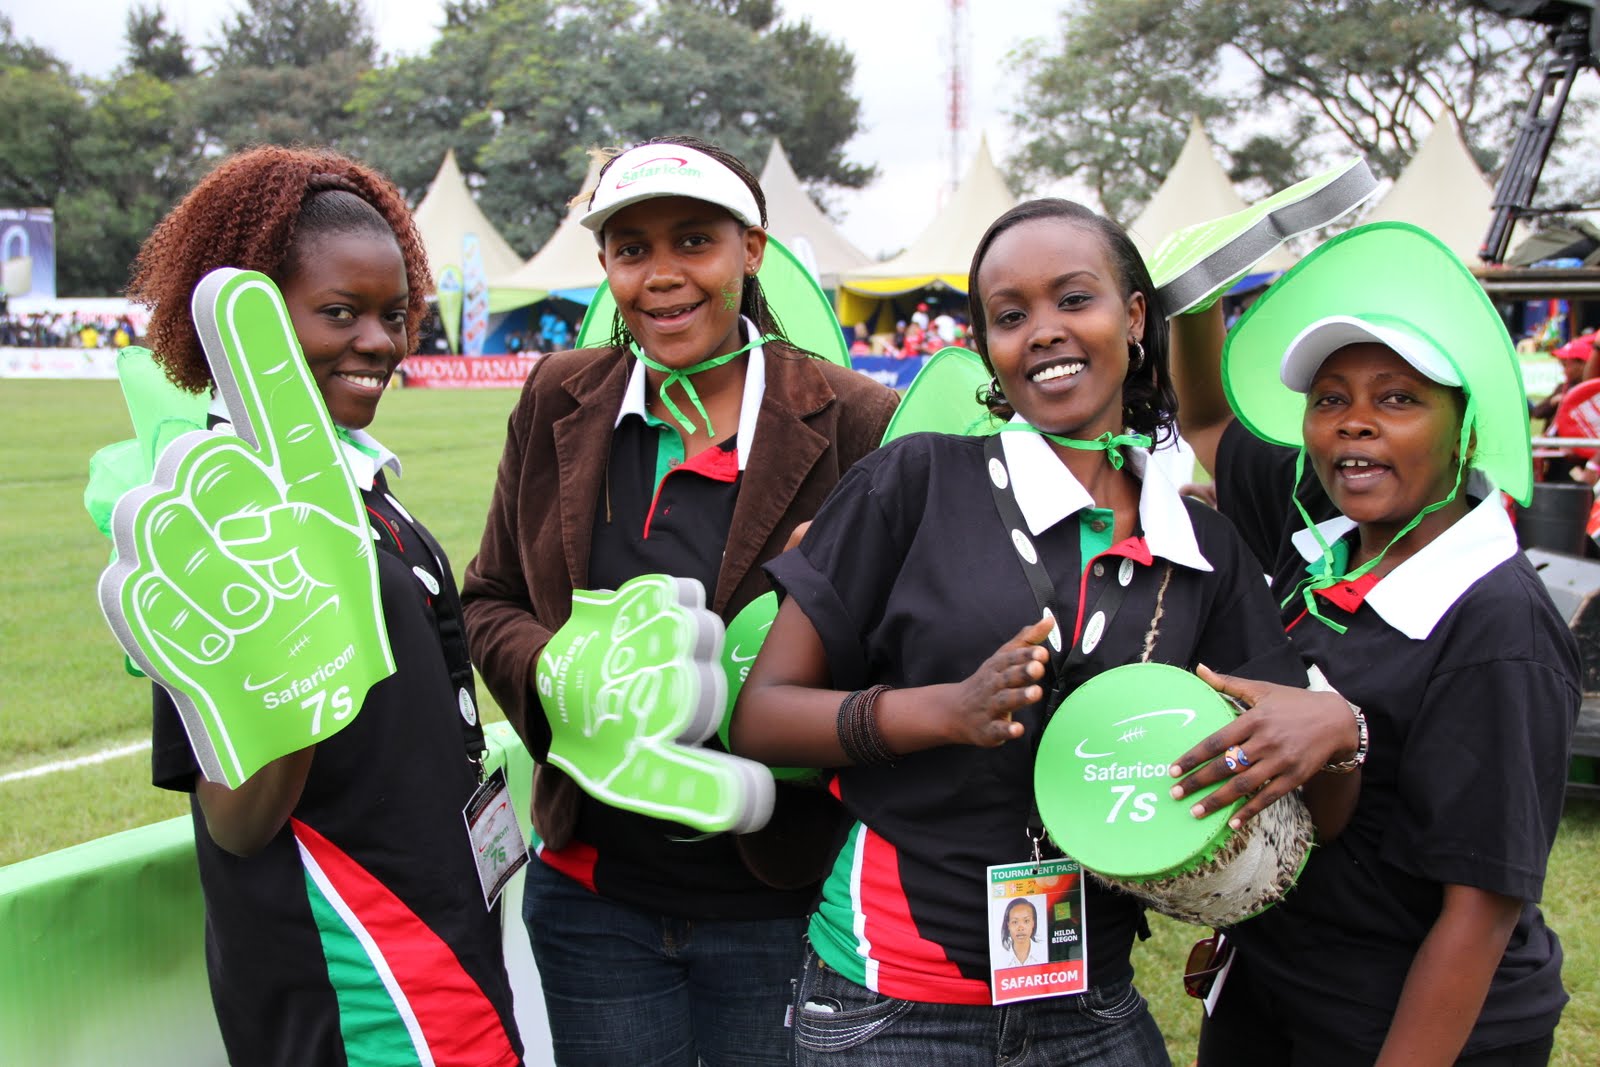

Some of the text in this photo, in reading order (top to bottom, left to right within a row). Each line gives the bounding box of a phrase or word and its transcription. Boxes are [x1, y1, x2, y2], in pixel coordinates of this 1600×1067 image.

[622, 164, 704, 183] Safaricom
[263, 643, 356, 710] Safaricom
[556, 635, 586, 723] Safaricom
[1056, 862, 1079, 873] PASS
[1051, 935, 1078, 944] BIEGON
[1053, 929, 1076, 937] HILDA
[1001, 969, 1078, 991] SAFARICOM
